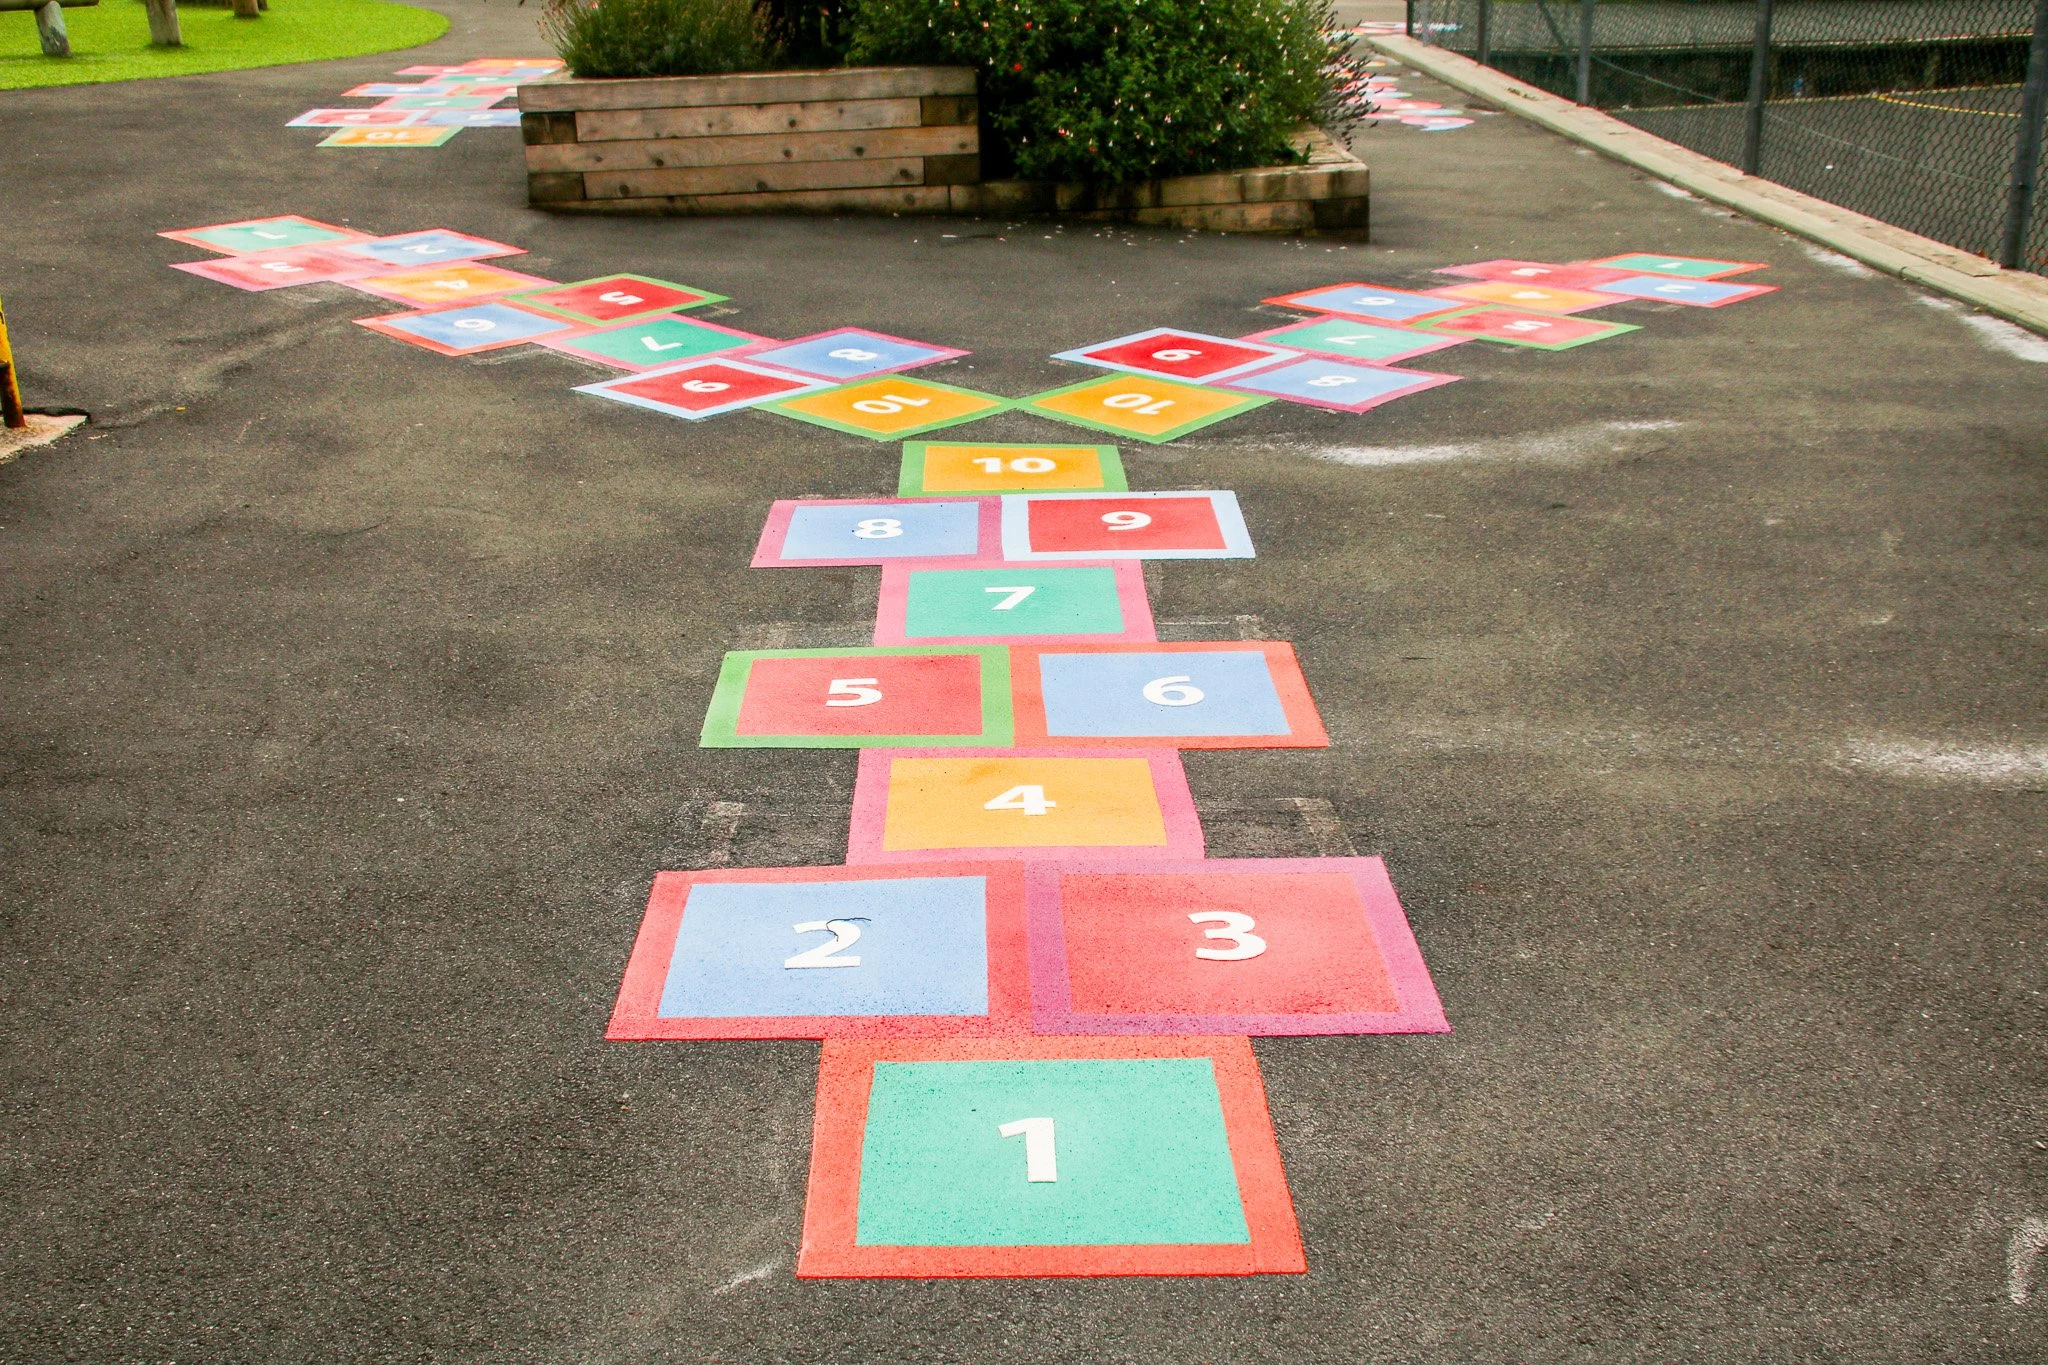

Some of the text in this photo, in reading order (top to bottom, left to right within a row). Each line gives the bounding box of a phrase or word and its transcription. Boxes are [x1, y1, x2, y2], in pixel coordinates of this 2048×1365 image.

[402, 244, 446, 255] 2
[260, 262, 304, 273] 3
[599, 292, 644, 306] 5
[640, 336, 683, 352] 7
[828, 349, 879, 362] 8
[852, 395, 930, 414] 10
[1103, 394, 1175, 415] 10
[974, 458, 1055, 473] 10
[855, 519, 903, 538] 8
[1102, 512, 1151, 530] 9
[985, 586, 1035, 610] 7
[826, 678, 882, 706] 5
[1143, 676, 1204, 705] 6
[984, 785, 1056, 815] 4
[784, 921, 861, 968] 2
[1188, 911, 1266, 960] 3
[998, 1118, 1057, 1181] 1
